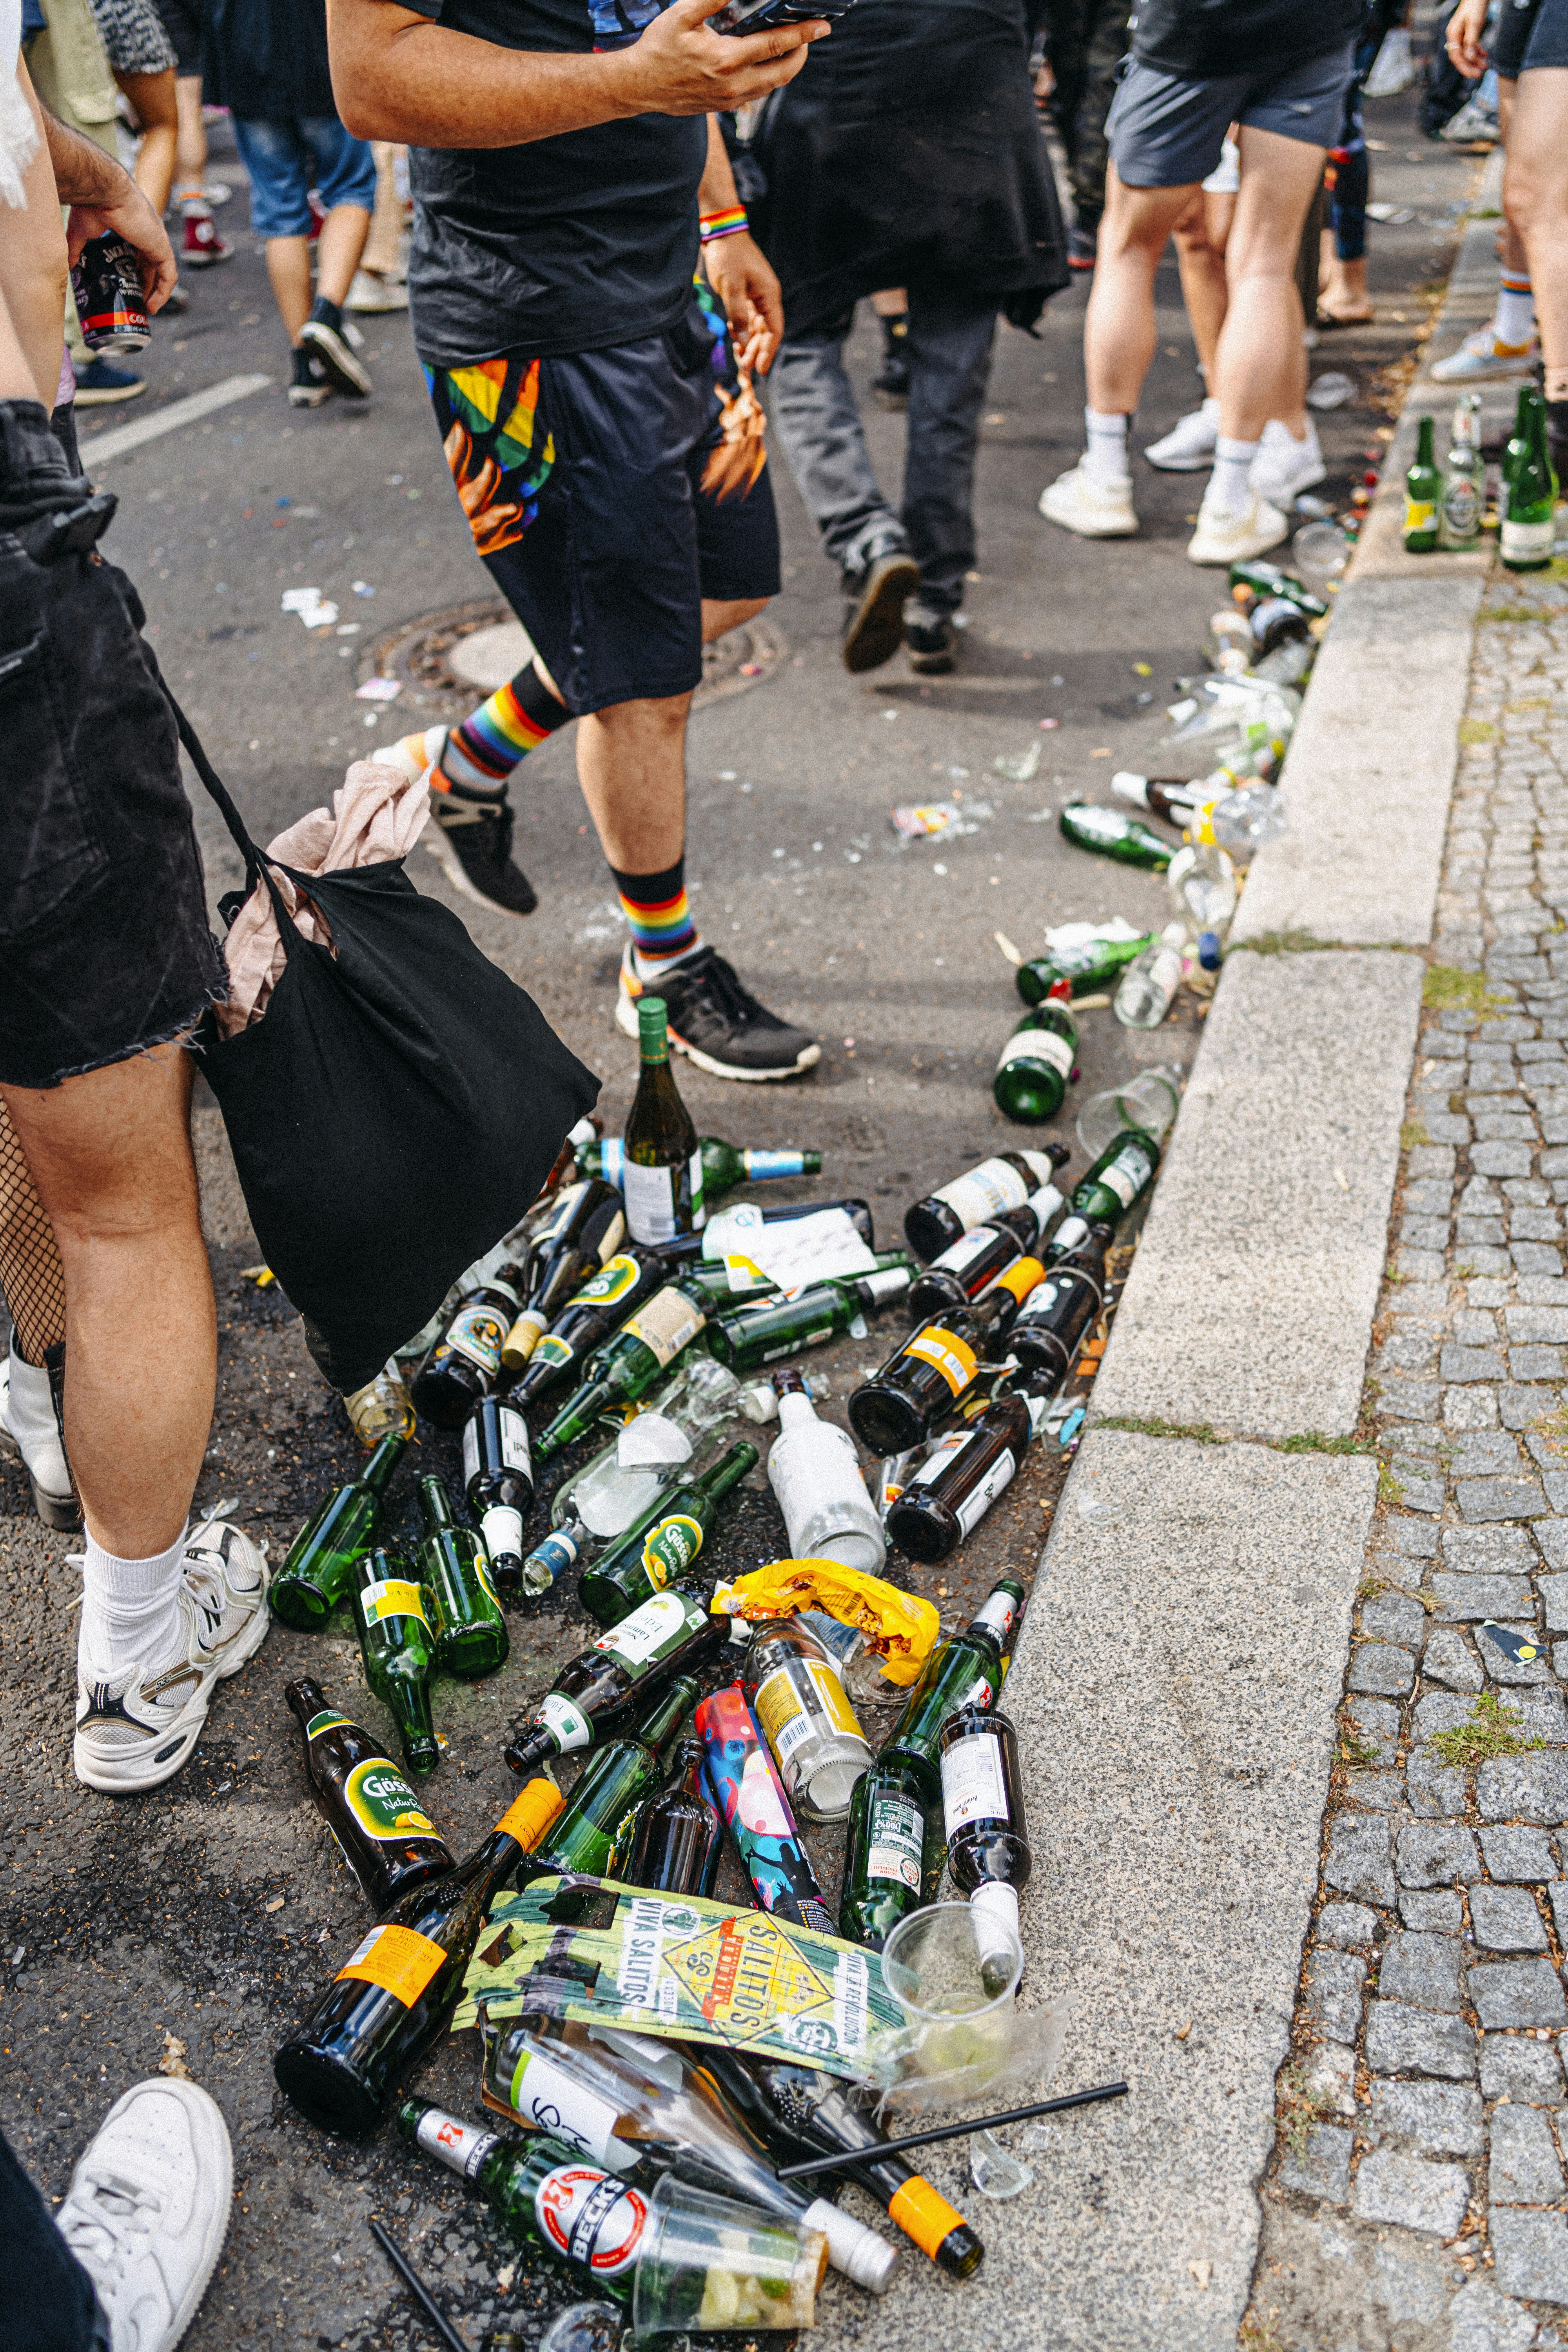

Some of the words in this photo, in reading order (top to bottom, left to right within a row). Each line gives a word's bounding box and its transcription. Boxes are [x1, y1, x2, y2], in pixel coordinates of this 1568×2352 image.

[155, 1673, 172, 1690] 530
[951, 1804, 963, 1816] Kindl
[960, 1795, 978, 1806] Berliner
[634, 1900, 659, 1935] VIVA
[622, 1938, 655, 2004] SALITOS
[712, 1935, 736, 2002] TEQUILA
[730, 1925, 778, 2028] SALITOS
[850, 1953, 864, 1973] VIVA
[572, 2177, 625, 2261] BECK'S
